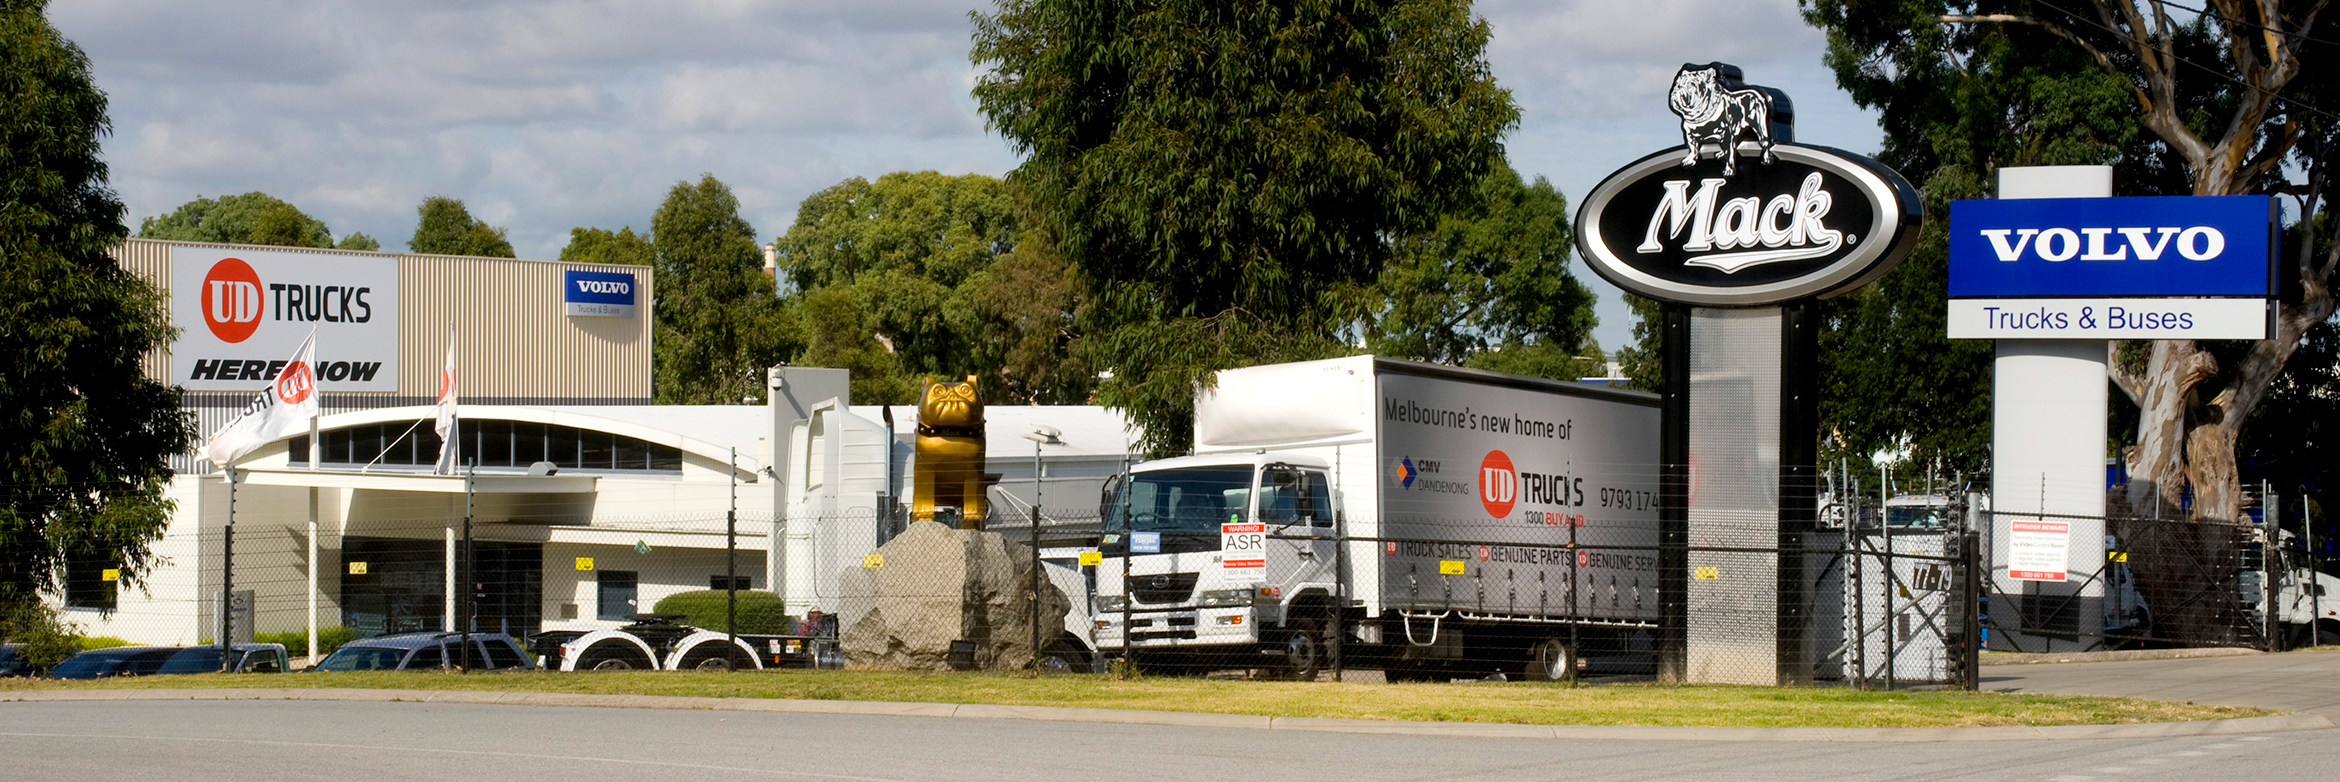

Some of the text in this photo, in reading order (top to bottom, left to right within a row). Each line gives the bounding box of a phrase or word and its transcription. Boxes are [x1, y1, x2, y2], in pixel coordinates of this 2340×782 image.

[1637, 172, 1843, 274] Mack
[1980, 226, 2225, 262] VOLVO
[576, 280, 629, 295] VOLVO
[210, 280, 371, 323] UD TRUCKS
[577, 304, 596, 313] Trucks
[604, 306, 620, 314] Buses
[1983, 306, 2194, 330] Trucks & Buses
[191, 359, 290, 380] HERE
[1385, 397, 1571, 440] Melbourne's new home of
[1419, 460, 1440, 473] CMV
[1419, 479, 1469, 495] DANDENONG
[1484, 467, 1584, 507] UD TRUCKS
[1600, 487, 1659, 512] 9793 174
[1525, 511, 1544, 524] 1300
[1546, 512, 1563, 525] BUY
[1225, 534, 1262, 550] ASR
[1400, 541, 1435, 557] TRUCK
[1438, 542, 1472, 559] SALES
[1491, 546, 1537, 564] GENUINE
[1541, 549, 1571, 566] PARTS
[1590, 552, 1633, 571] GENUINE
[1635, 556, 1659, 572] SERV
